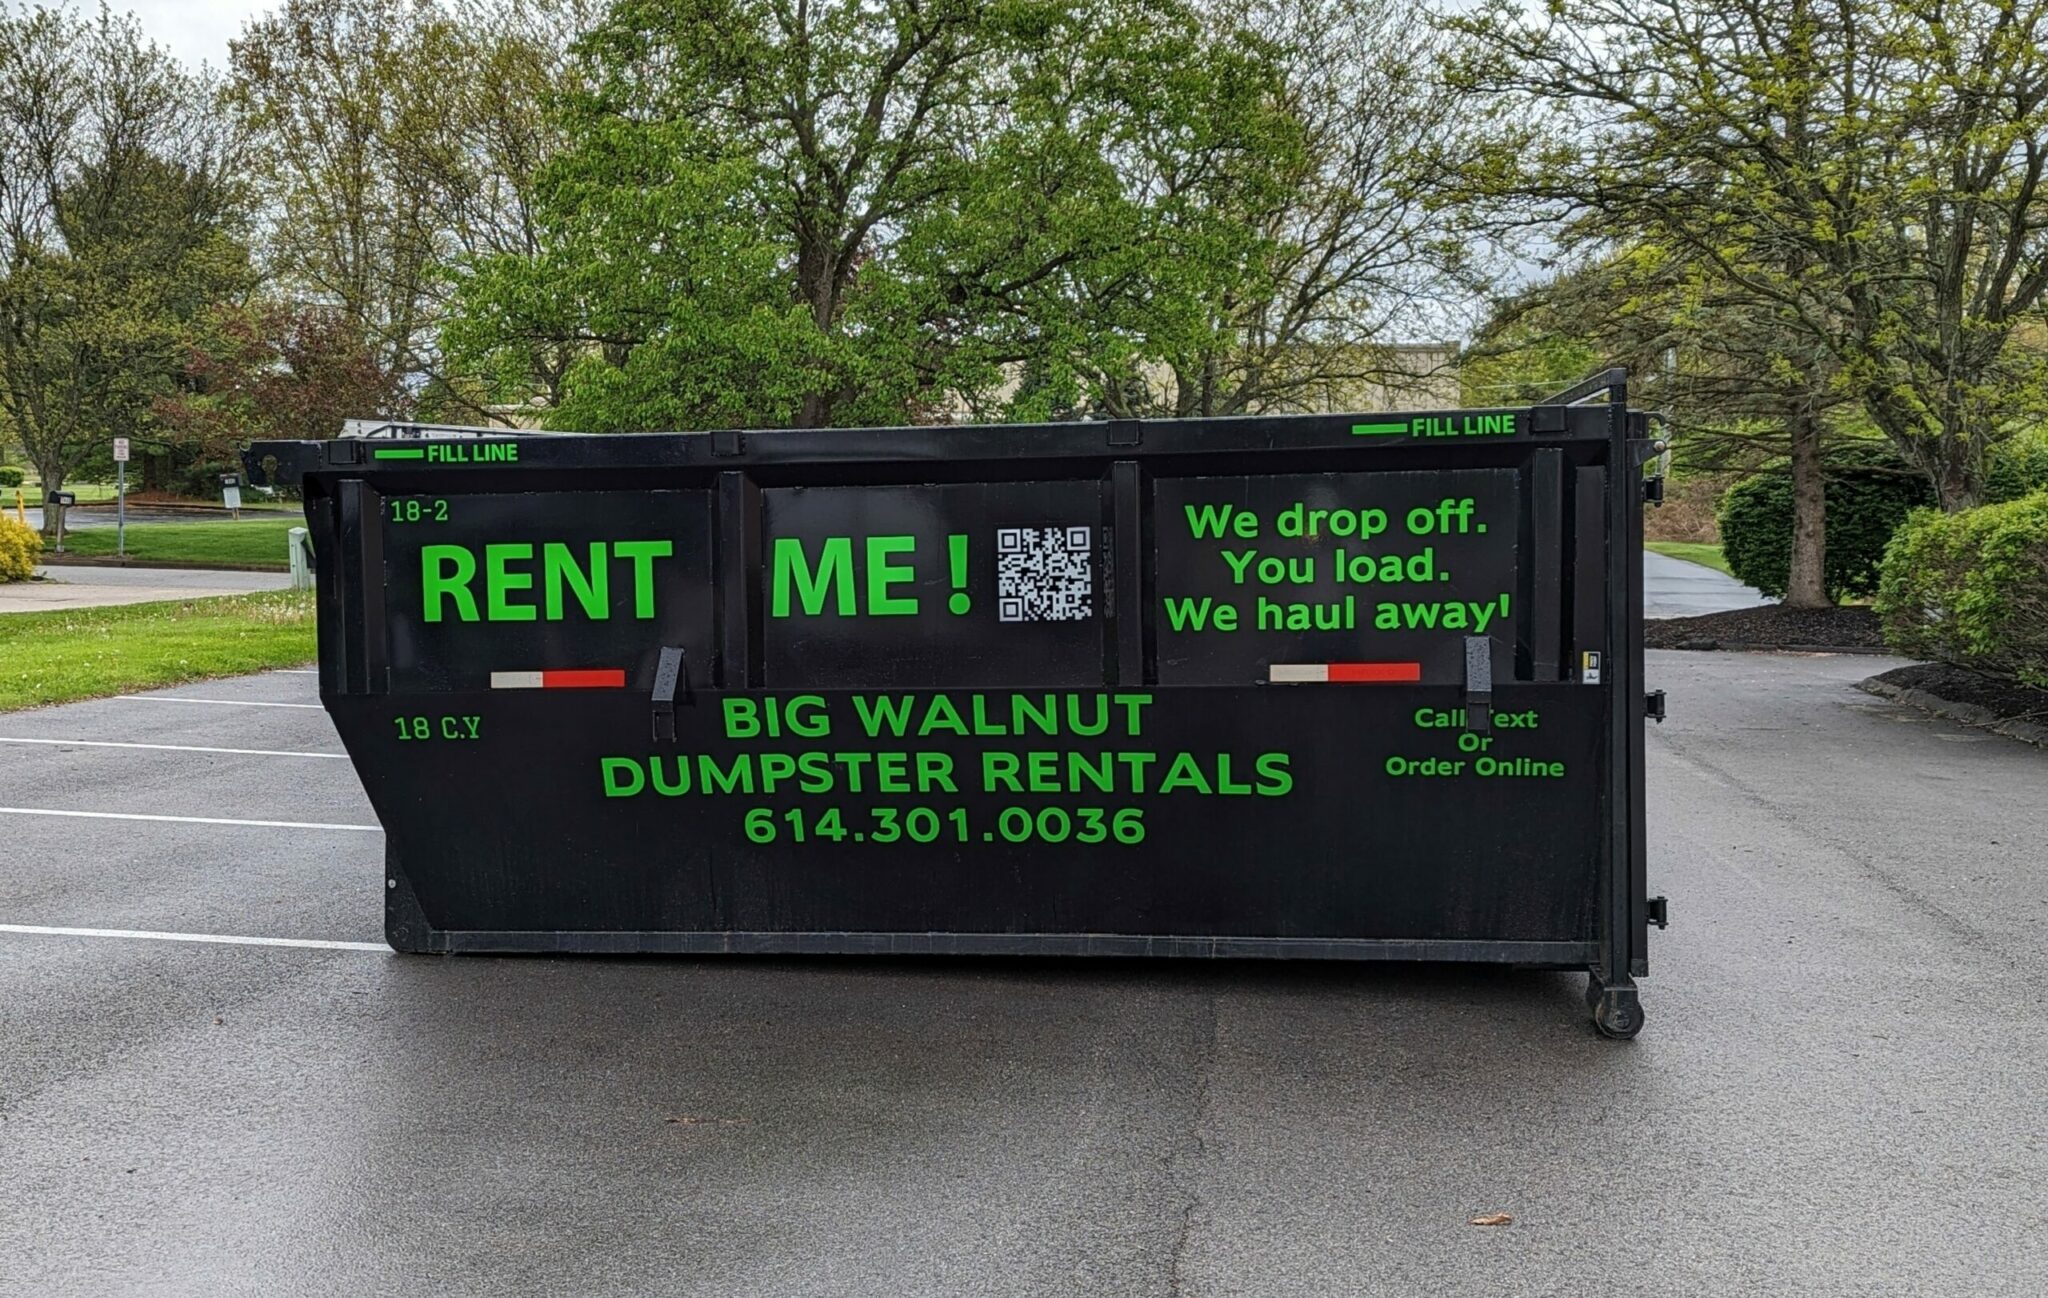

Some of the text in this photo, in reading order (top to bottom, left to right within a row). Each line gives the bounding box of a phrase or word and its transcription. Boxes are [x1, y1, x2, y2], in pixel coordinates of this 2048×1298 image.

[1411, 414, 1515, 437] FILL LINE
[427, 444, 518, 462] FILL LINE
[391, 500, 448, 521] 18-2
[1185, 497, 1488, 541] We drop off.
[421, 534, 971, 623] RENT ME !
[1220, 547, 1450, 585] You load.
[1163, 596, 1238, 632] We
[1257, 595, 1355, 631] haul
[394, 717, 430, 740] 18
[722, 693, 1153, 739] BIG WALNUT
[1487, 709, 1539, 729] ext
[1458, 732, 1494, 752] Or
[600, 751, 1293, 798] DUMPSTER RENTALS
[1385, 756, 1565, 777] Order Online
[744, 806, 1146, 845] 614.301.0036
